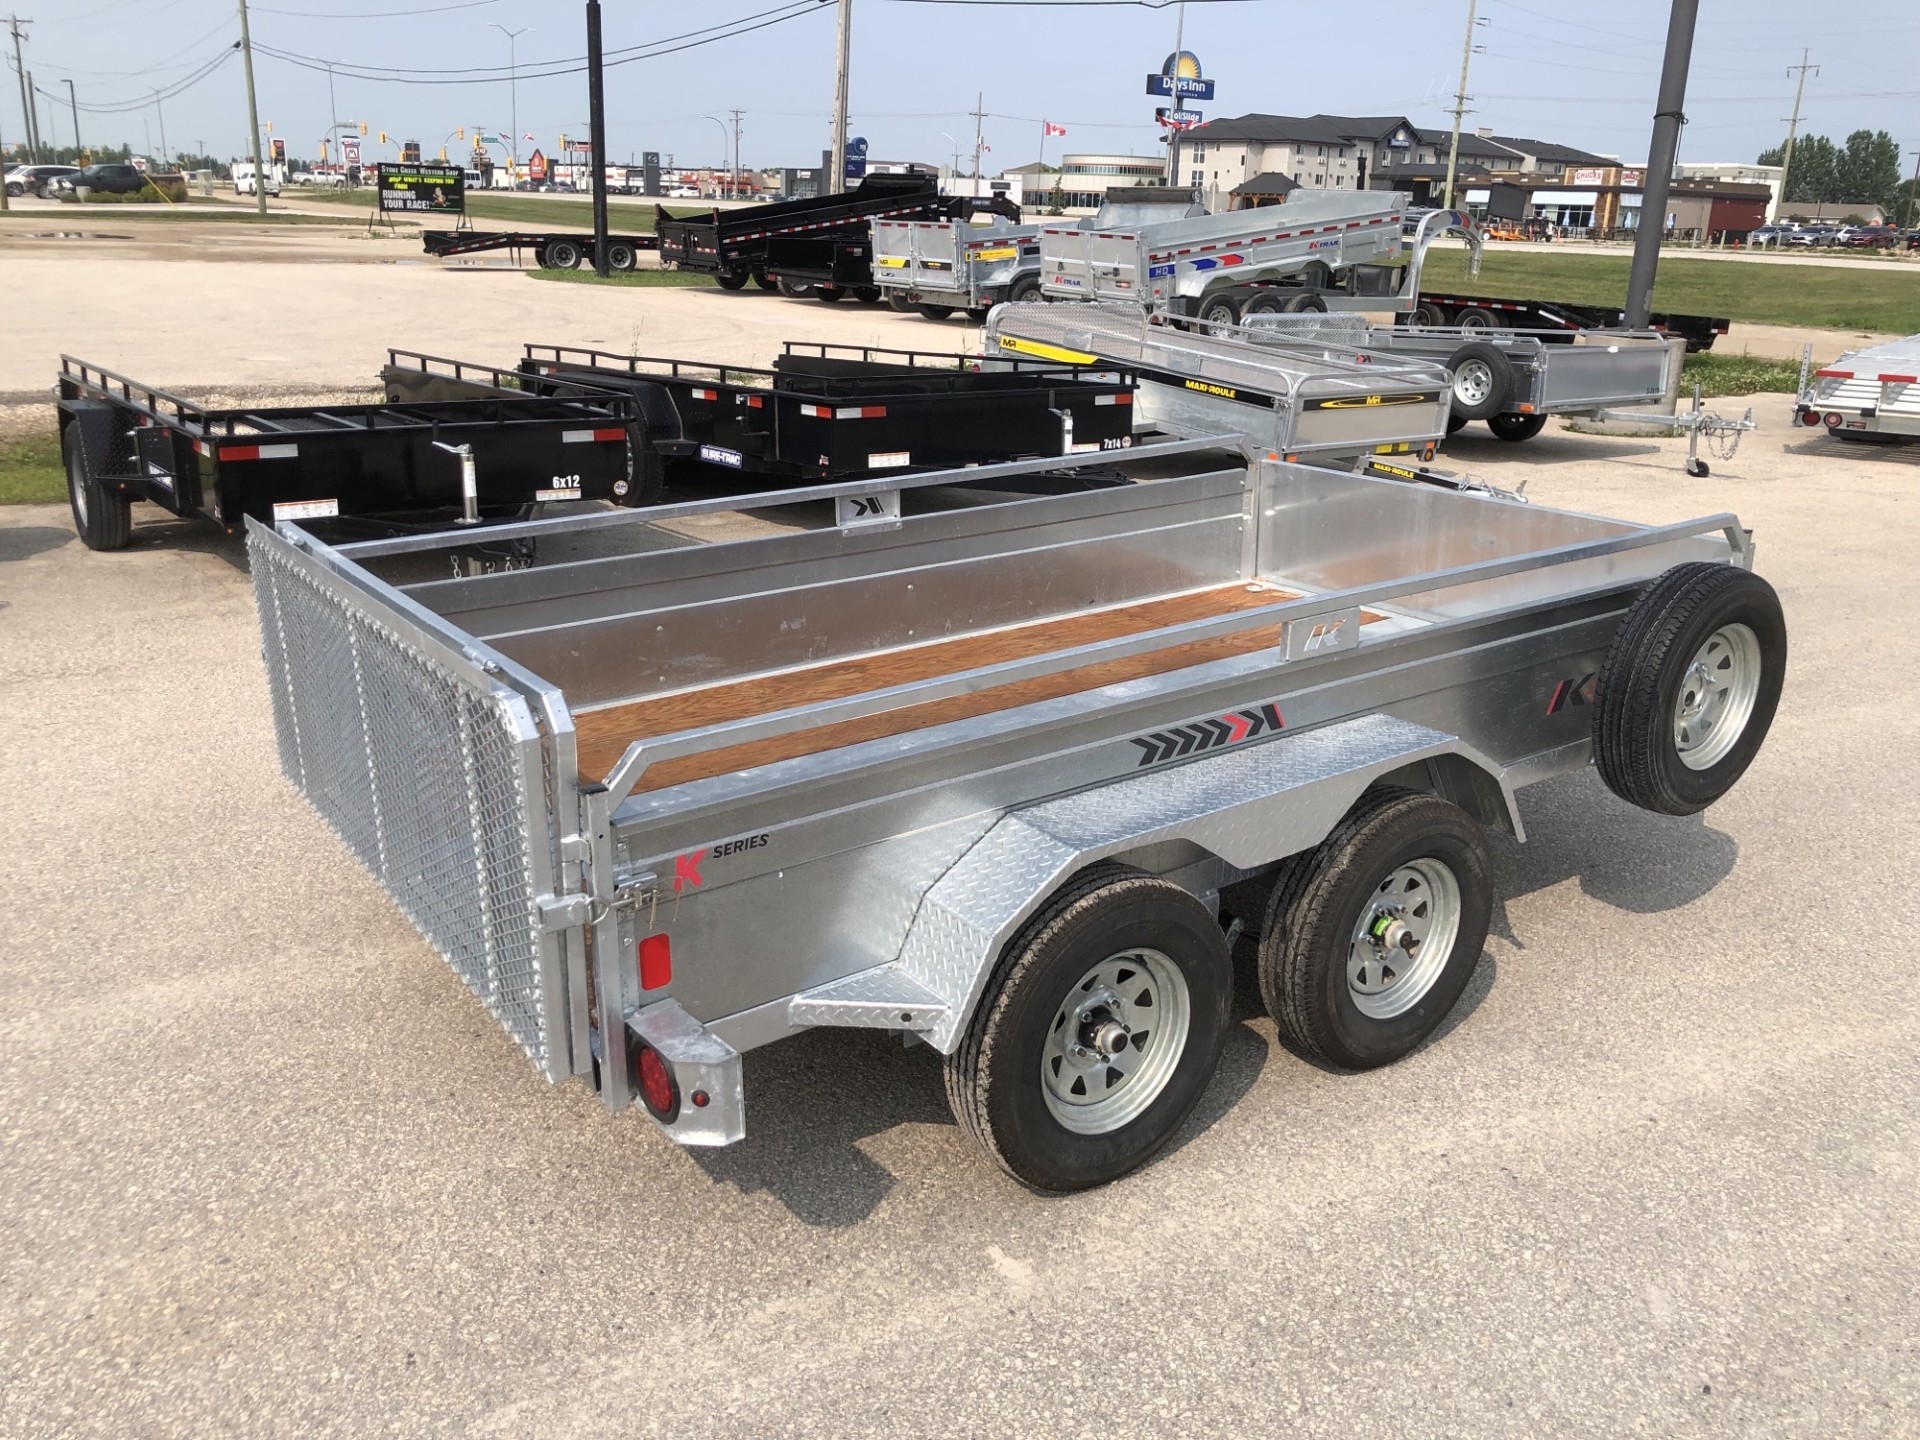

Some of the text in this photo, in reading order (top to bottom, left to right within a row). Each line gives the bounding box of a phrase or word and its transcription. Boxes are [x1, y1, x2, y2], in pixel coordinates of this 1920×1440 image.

[1188, 80, 1206, 92] Inn
[382, 189, 416, 199] RUNNING
[383, 200, 430, 210] YOUR RACE!
[1155, 266, 1169, 276] HD
[1185, 379, 1236, 399] MAXI-ROULE
[1104, 438, 1121, 449] 7x14
[702, 447, 741, 466] SURE-TRAC
[1374, 462, 1415, 480] MAXI-ROULE
[552, 475, 580, 489] 6x12
[673, 833, 770, 892] K SERIES
